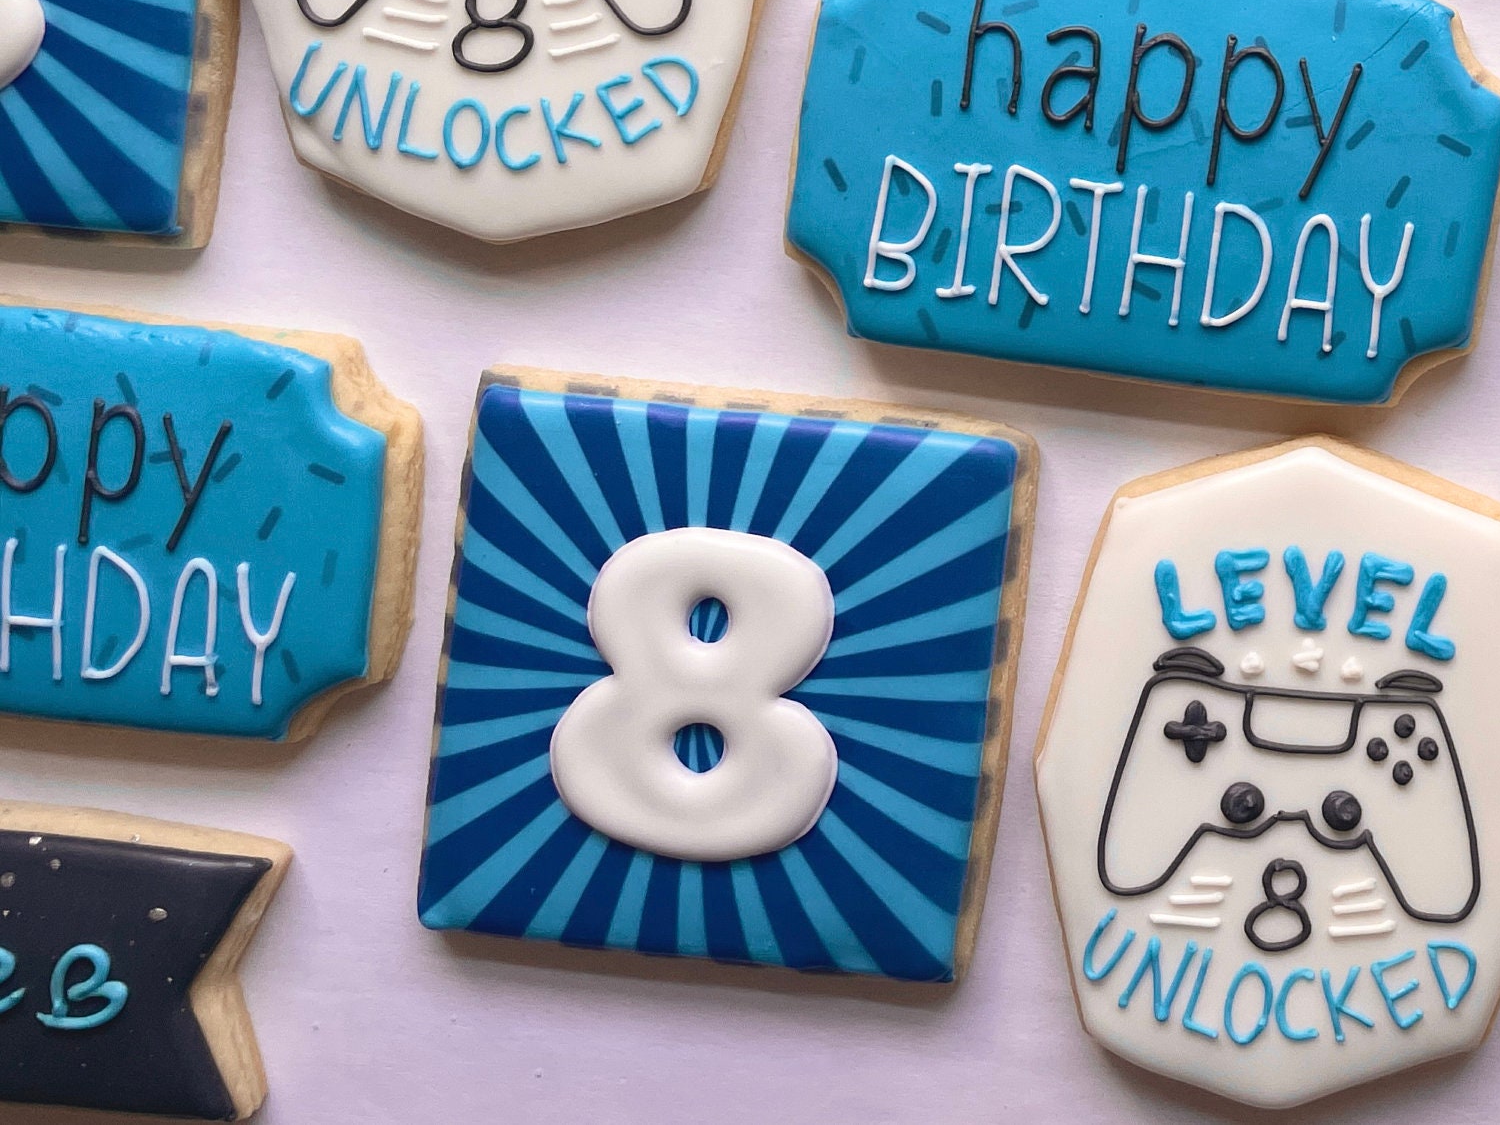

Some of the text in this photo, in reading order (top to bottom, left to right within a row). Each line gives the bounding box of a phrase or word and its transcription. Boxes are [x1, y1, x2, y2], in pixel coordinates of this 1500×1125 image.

[289, 40, 700, 171] UNLOCKED
[864, 154, 1415, 358] BIRTHDAY
[1154, 545, 1456, 661] LEVEL
[550, 527, 838, 861] 8
[1244, 857, 1311, 951] 8
[1083, 908, 1477, 1045] UNLOCKED
